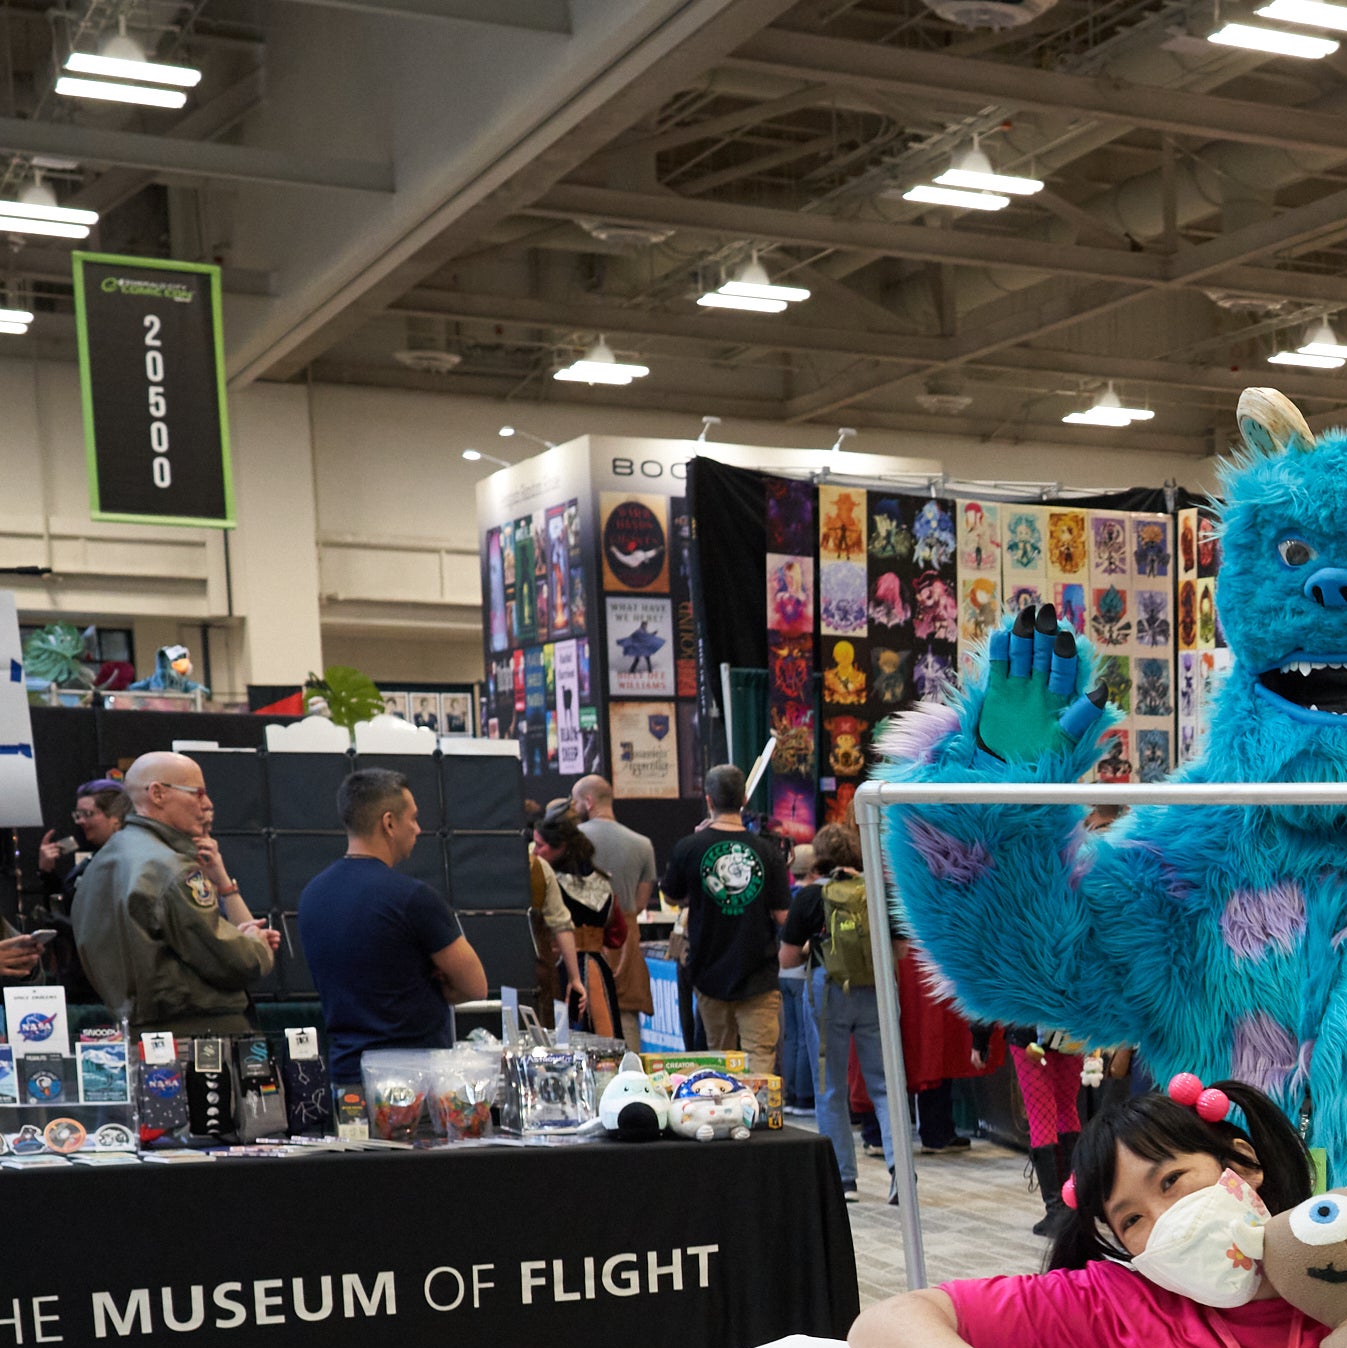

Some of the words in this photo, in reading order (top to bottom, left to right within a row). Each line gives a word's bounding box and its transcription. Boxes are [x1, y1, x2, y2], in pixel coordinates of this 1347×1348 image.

[143, 314, 172, 489] 20500
[21, 1022, 52, 1031] NASA
[82, 1028, 118, 1037] SNOOPY
[665, 1061, 695, 1070] CREATOR
[149, 1080, 180, 1090] NASA
[92, 1271, 398, 1338] MUSEUM
[424, 1263, 496, 1312] OF
[520, 1243, 720, 1305] FLIGHT
